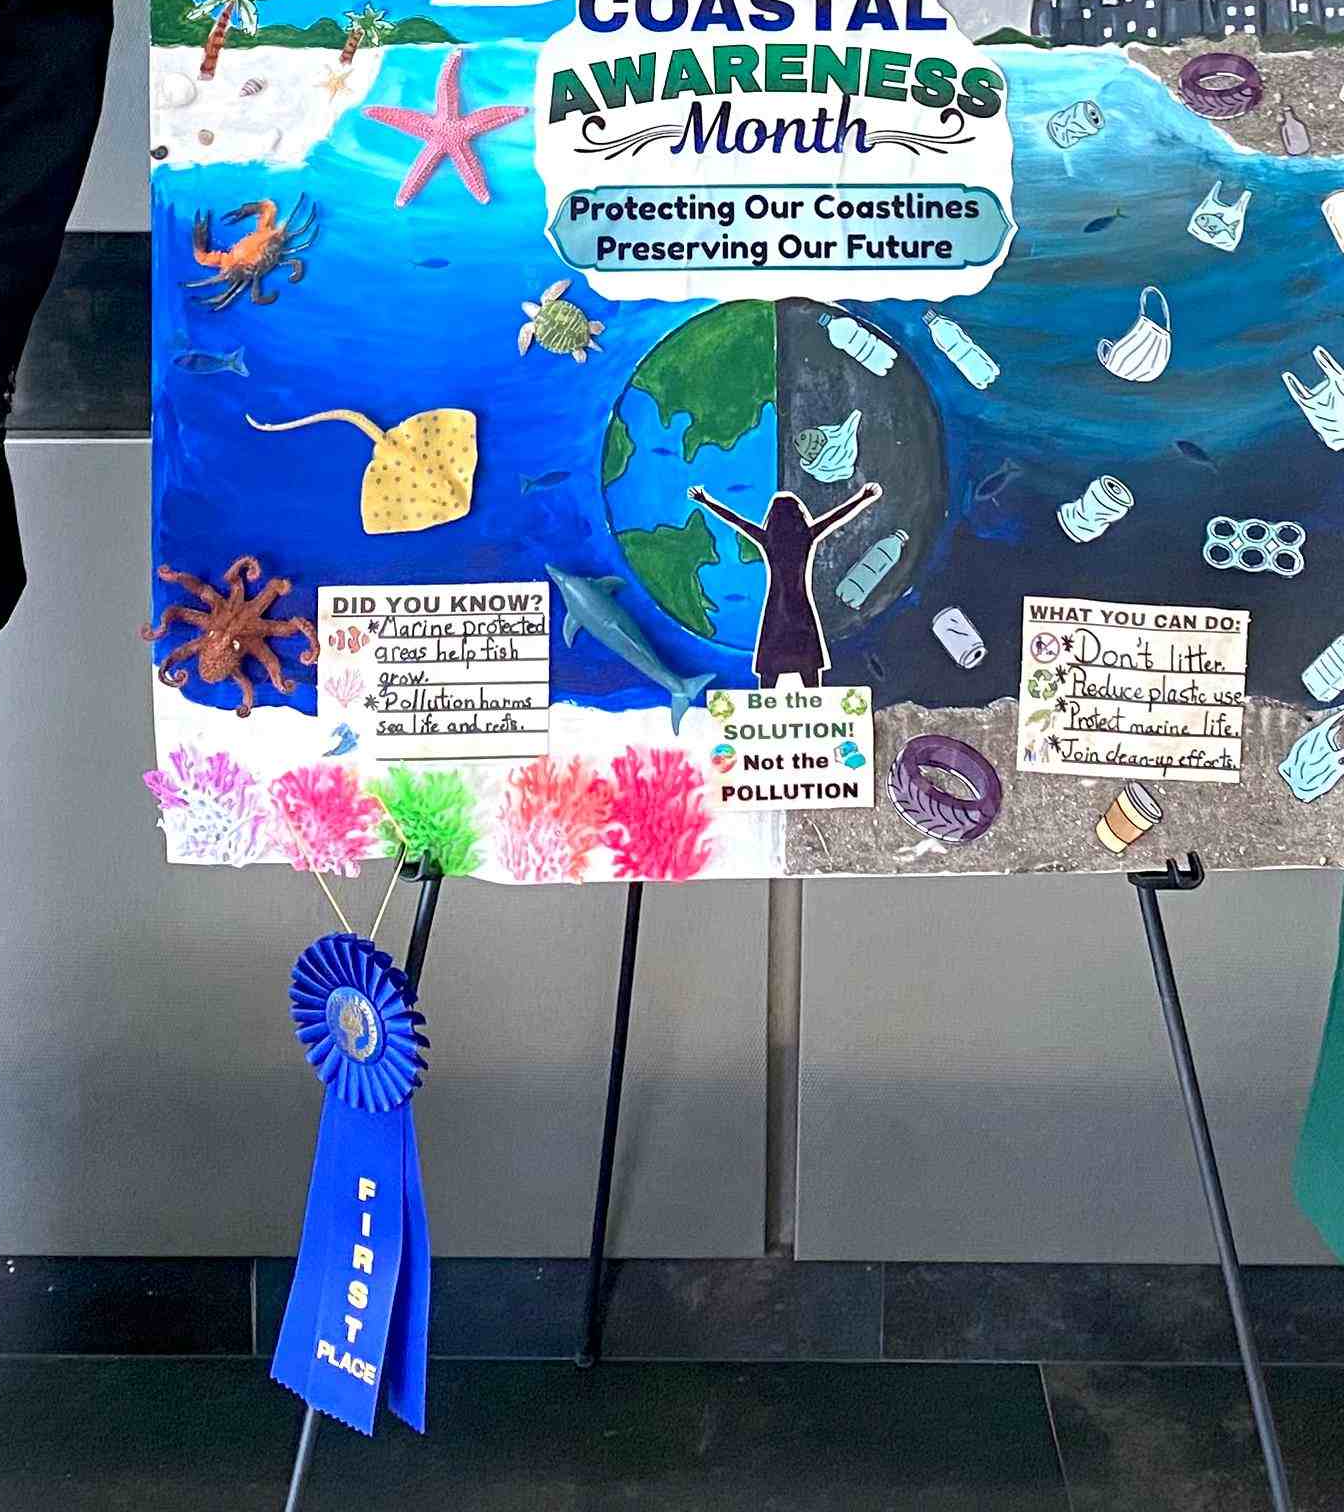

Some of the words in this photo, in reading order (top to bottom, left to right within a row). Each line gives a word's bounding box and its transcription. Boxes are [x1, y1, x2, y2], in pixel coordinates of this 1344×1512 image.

[549, 43, 1004, 124] AWARENESS
[670, 94, 876, 156] Month
[570, 194, 735, 224] Protecting
[744, 196, 804, 219] Our
[814, 193, 980, 219] Coastlines
[597, 234, 768, 265] Preserving
[777, 236, 837, 260] Our
[847, 234, 953, 259] Future
[332, 596, 376, 614] DID
[386, 595, 440, 613] YOU
[450, 593, 543, 612] KNOW?
[1030, 605, 1092, 622] WHAT
[1101, 609, 1146, 627] YOU
[1154, 614, 1197, 630] CAN
[1206, 616, 1240, 631] DO:
[379, 615, 455, 637] Marine
[462, 615, 545, 637] protected
[374, 645, 428, 662] areas
[436, 638, 476, 669] help
[480, 637, 519, 661] fish
[1074, 628, 1154, 671] Don't
[1170, 644, 1226, 673] litter.
[378, 670, 430, 697] grow.
[384, 687, 475, 710] Pollution
[480, 687, 533, 710] harms
[1068, 665, 1144, 699] Reduce
[1148, 674, 1207, 713] plastic
[748, 693, 777, 709] Be
[786, 692, 823, 709] the
[377, 719, 404, 734] sea
[412, 714, 440, 733] life
[447, 714, 478, 733] and
[485, 713, 525, 732] reefs.
[724, 722, 855, 740] SOLUTION!
[1069, 701, 1127, 730] Protect
[1129, 719, 1191, 736] marine
[1203, 710, 1240, 737] life.
[743, 755, 784, 771] Not
[792, 753, 829, 769] the
[1061, 738, 1101, 763] Join
[1105, 742, 1173, 777] clean-up
[1178, 747, 1238, 769] efforts.
[722, 782, 859, 802] POLLUTION
[344, 1176, 377, 1344] FIRST
[316, 1338, 377, 1386] PLACE
